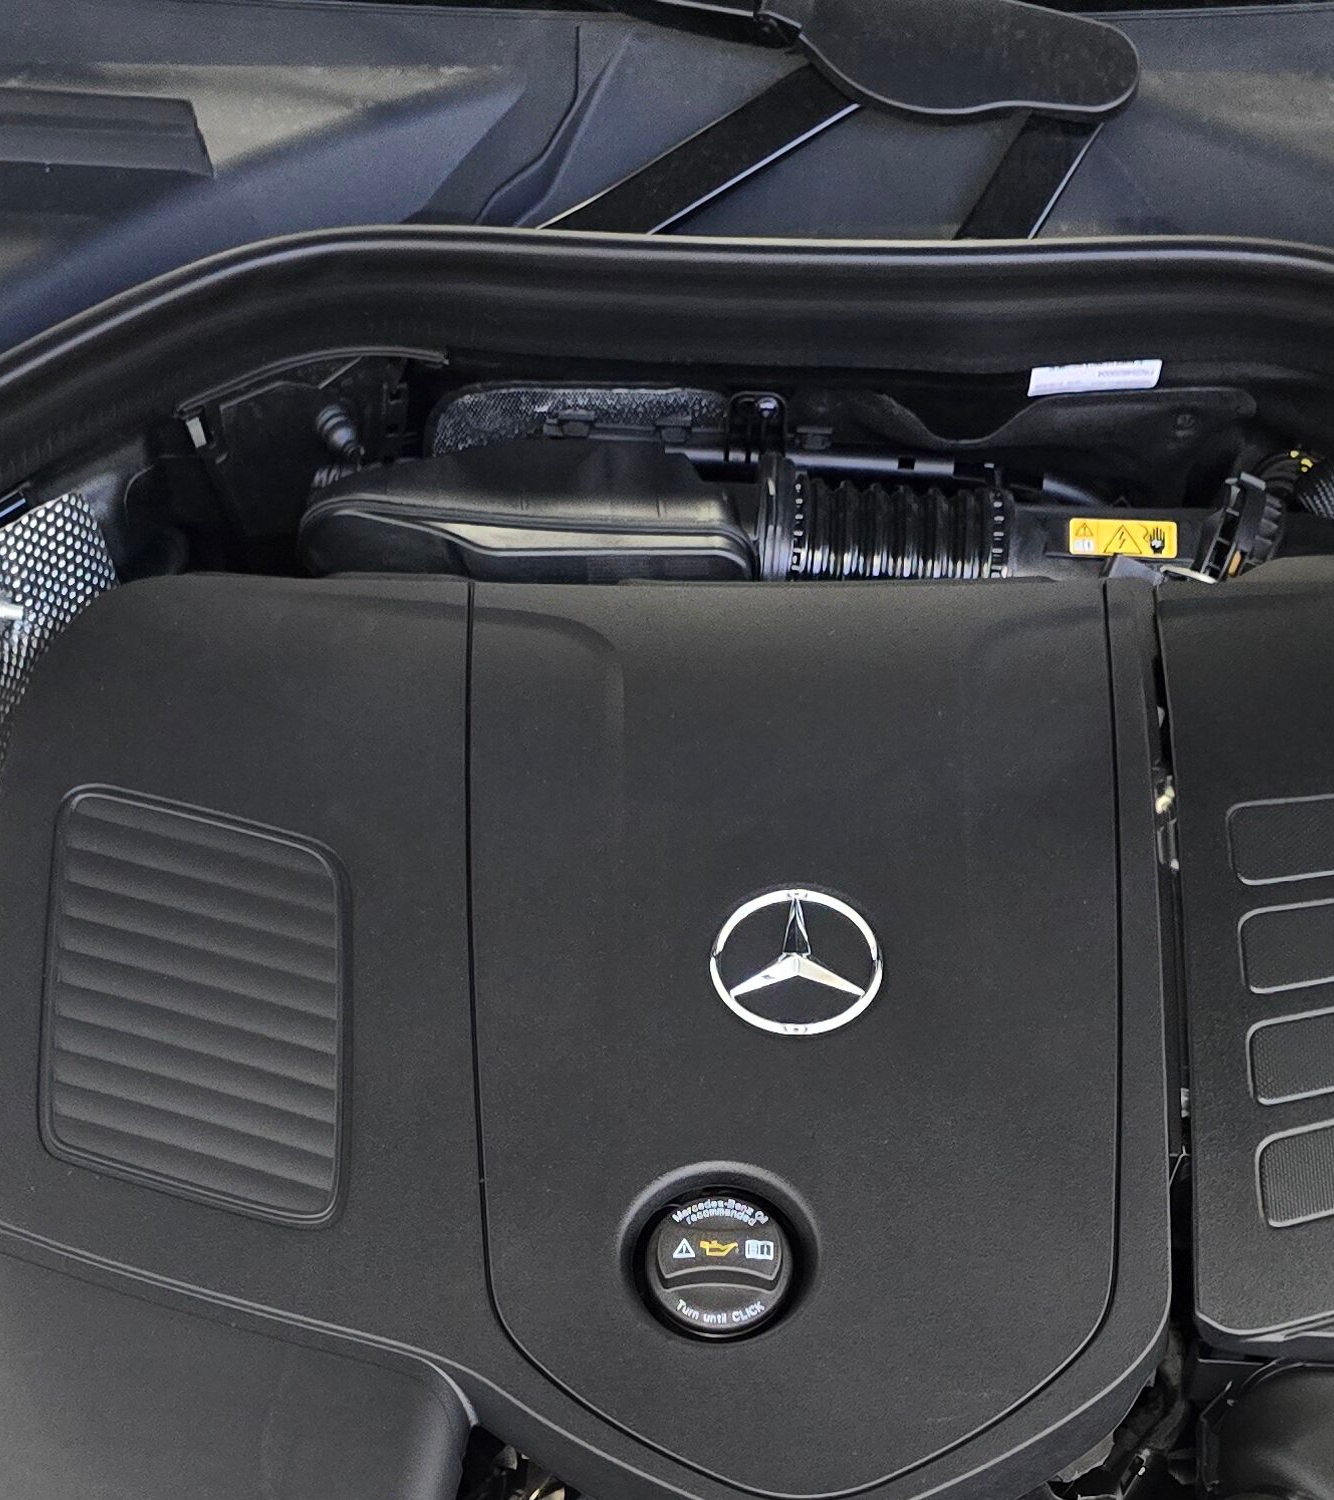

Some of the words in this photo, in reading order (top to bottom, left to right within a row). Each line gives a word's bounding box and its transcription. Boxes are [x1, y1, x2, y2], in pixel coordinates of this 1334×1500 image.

[671, 1198, 754, 1223] Mercedes-Benz
[685, 1207, 757, 1227] recommended
[675, 1298, 700, 1320] Turn
[703, 1312, 727, 1324] until
[731, 1300, 765, 1322] CLICK
